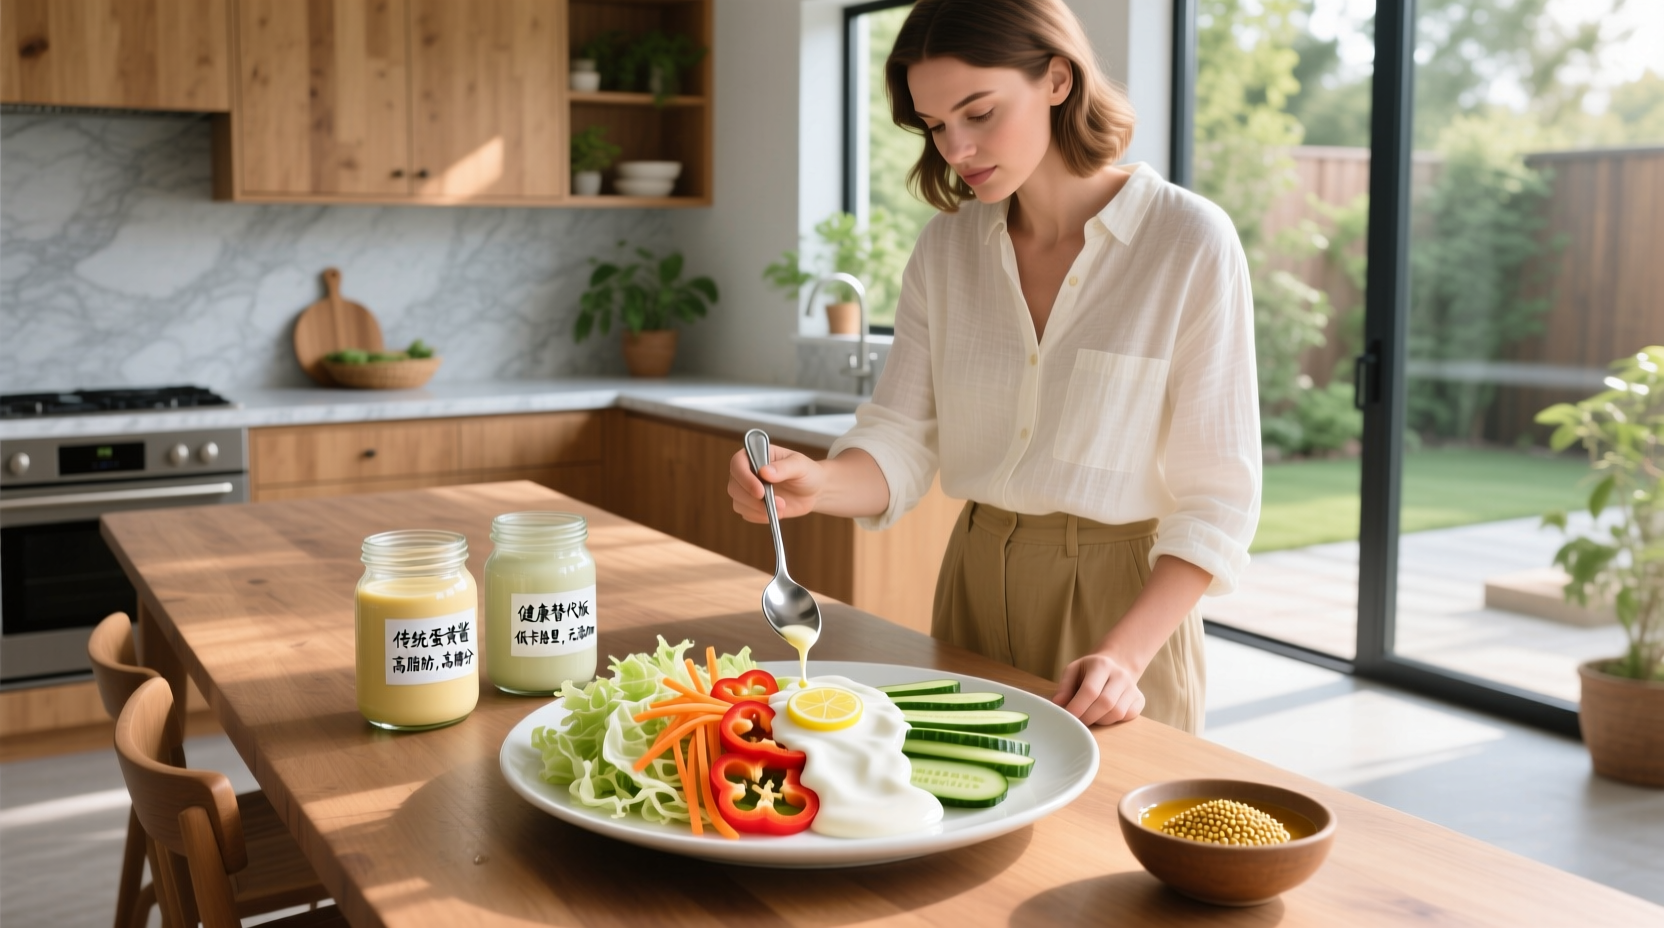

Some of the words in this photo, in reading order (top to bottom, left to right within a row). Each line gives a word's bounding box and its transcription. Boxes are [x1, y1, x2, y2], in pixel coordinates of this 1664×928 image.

[518, 600, 589, 622] 健康替代版
